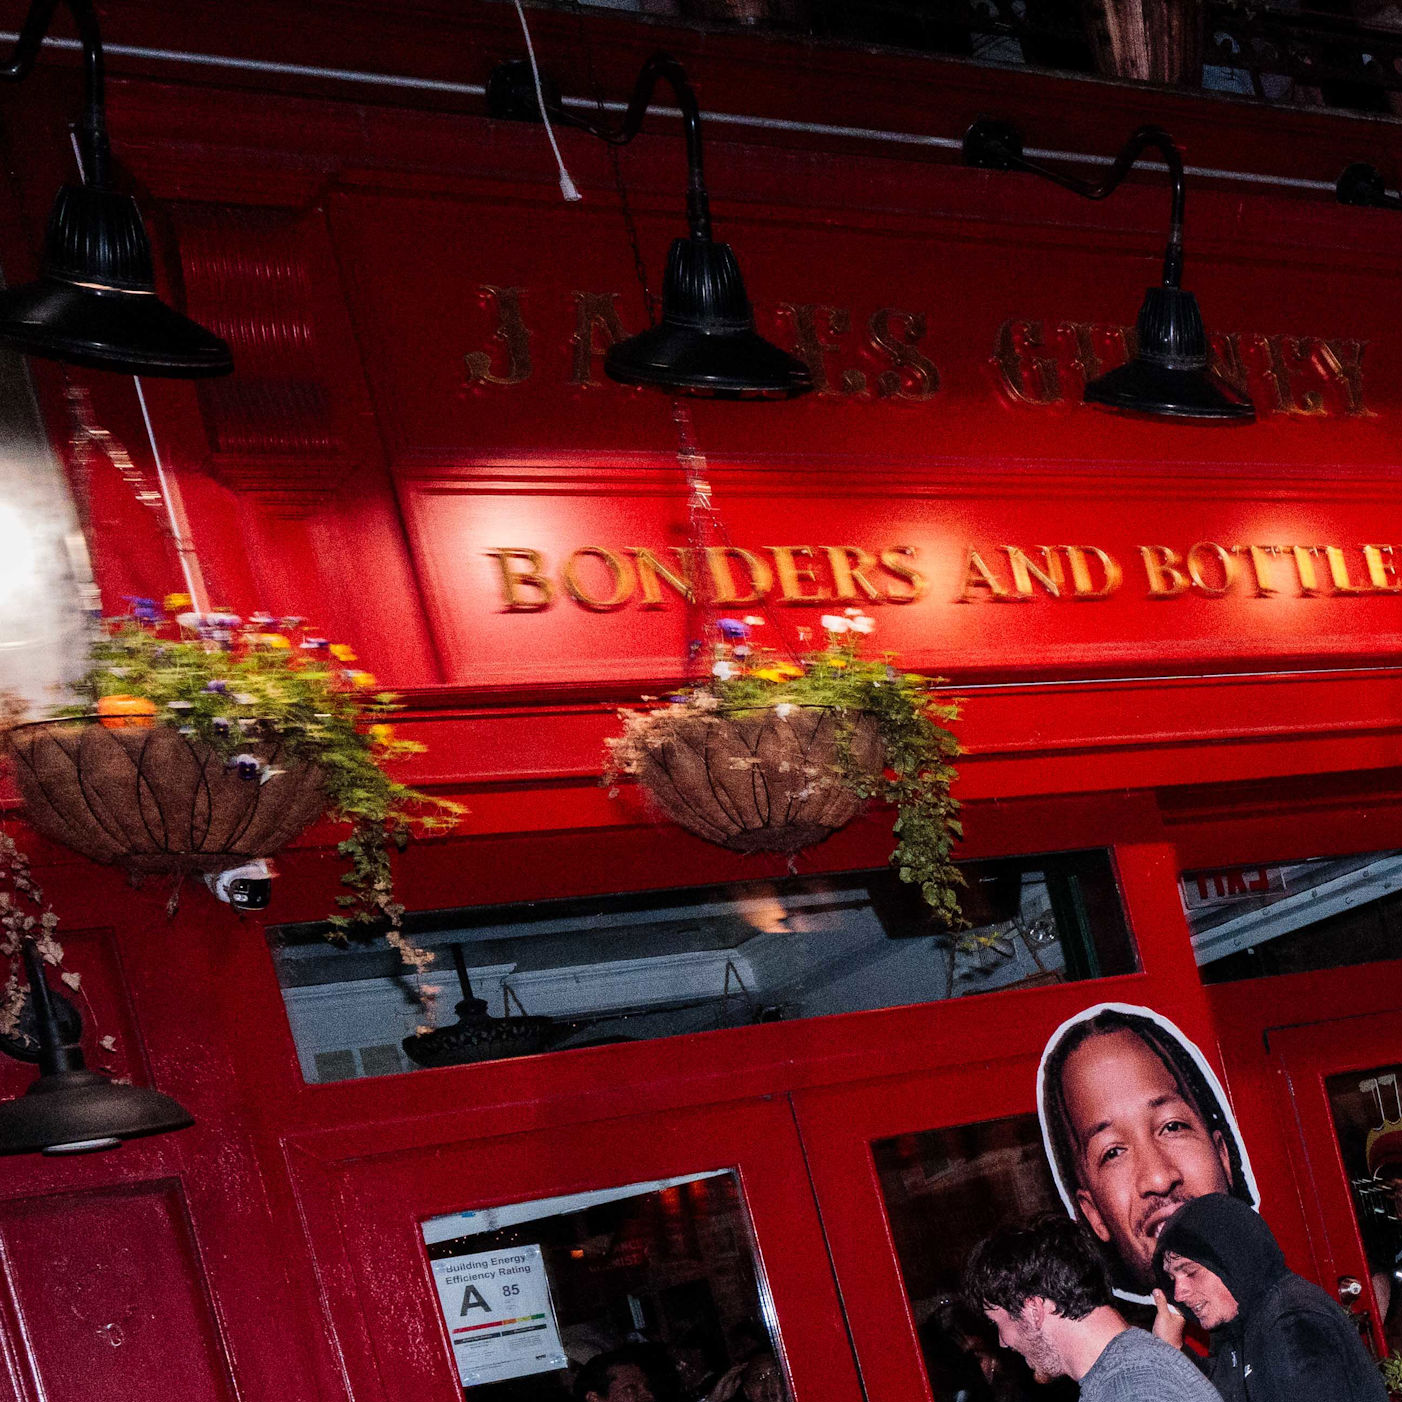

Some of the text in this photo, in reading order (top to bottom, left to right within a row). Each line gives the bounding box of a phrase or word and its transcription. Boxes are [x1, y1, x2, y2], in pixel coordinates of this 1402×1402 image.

[464, 284, 940, 400] JAES
[487, 544, 924, 614] BONDERS
[954, 544, 1122, 602] AND
[445, 1264, 532, 1286] Efficiency Rating
[446, 1254, 526, 1274] Building Energy
[460, 1284, 492, 1318] A
[502, 1283, 521, 1298] 85
